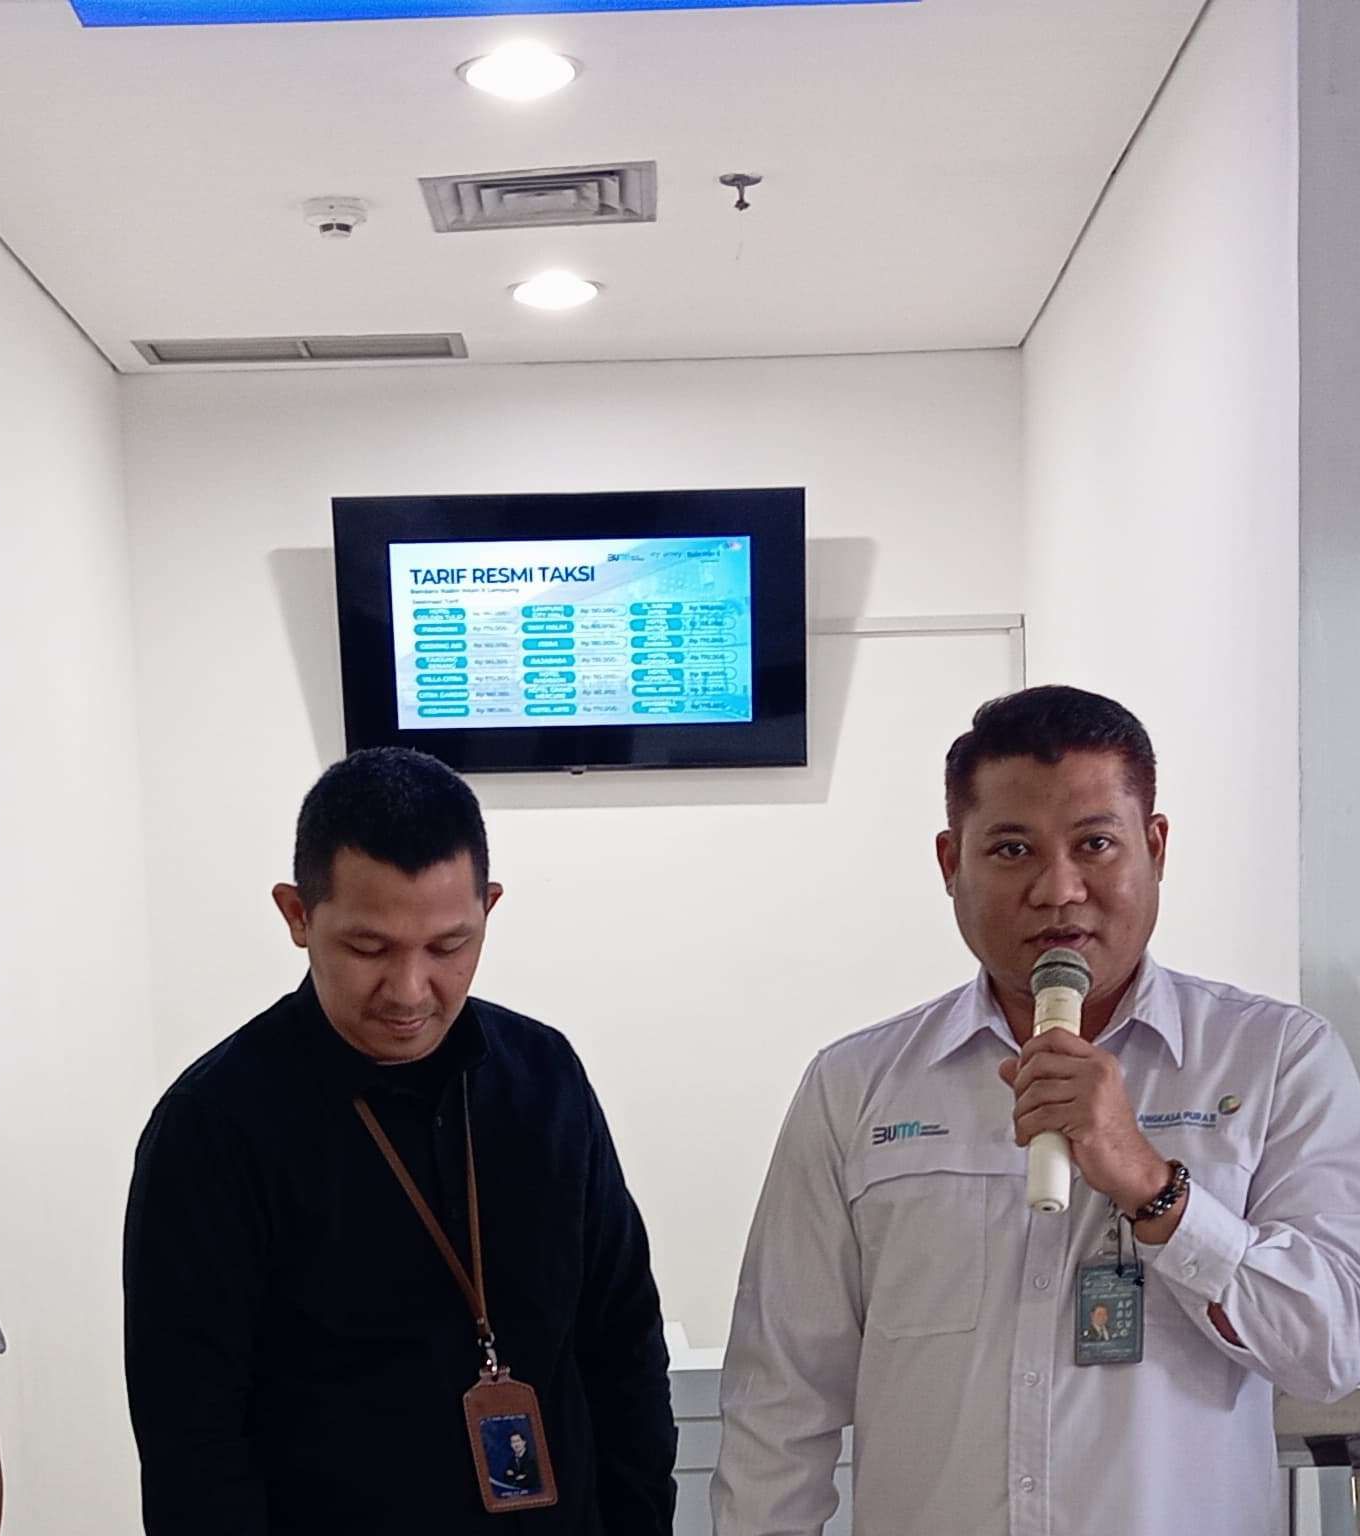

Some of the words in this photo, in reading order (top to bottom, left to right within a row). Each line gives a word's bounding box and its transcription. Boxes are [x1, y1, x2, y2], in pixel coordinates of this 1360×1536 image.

[409, 568, 468, 585] TARIF
[472, 567, 533, 584] RESMI
[538, 565, 595, 582] TAKSI
